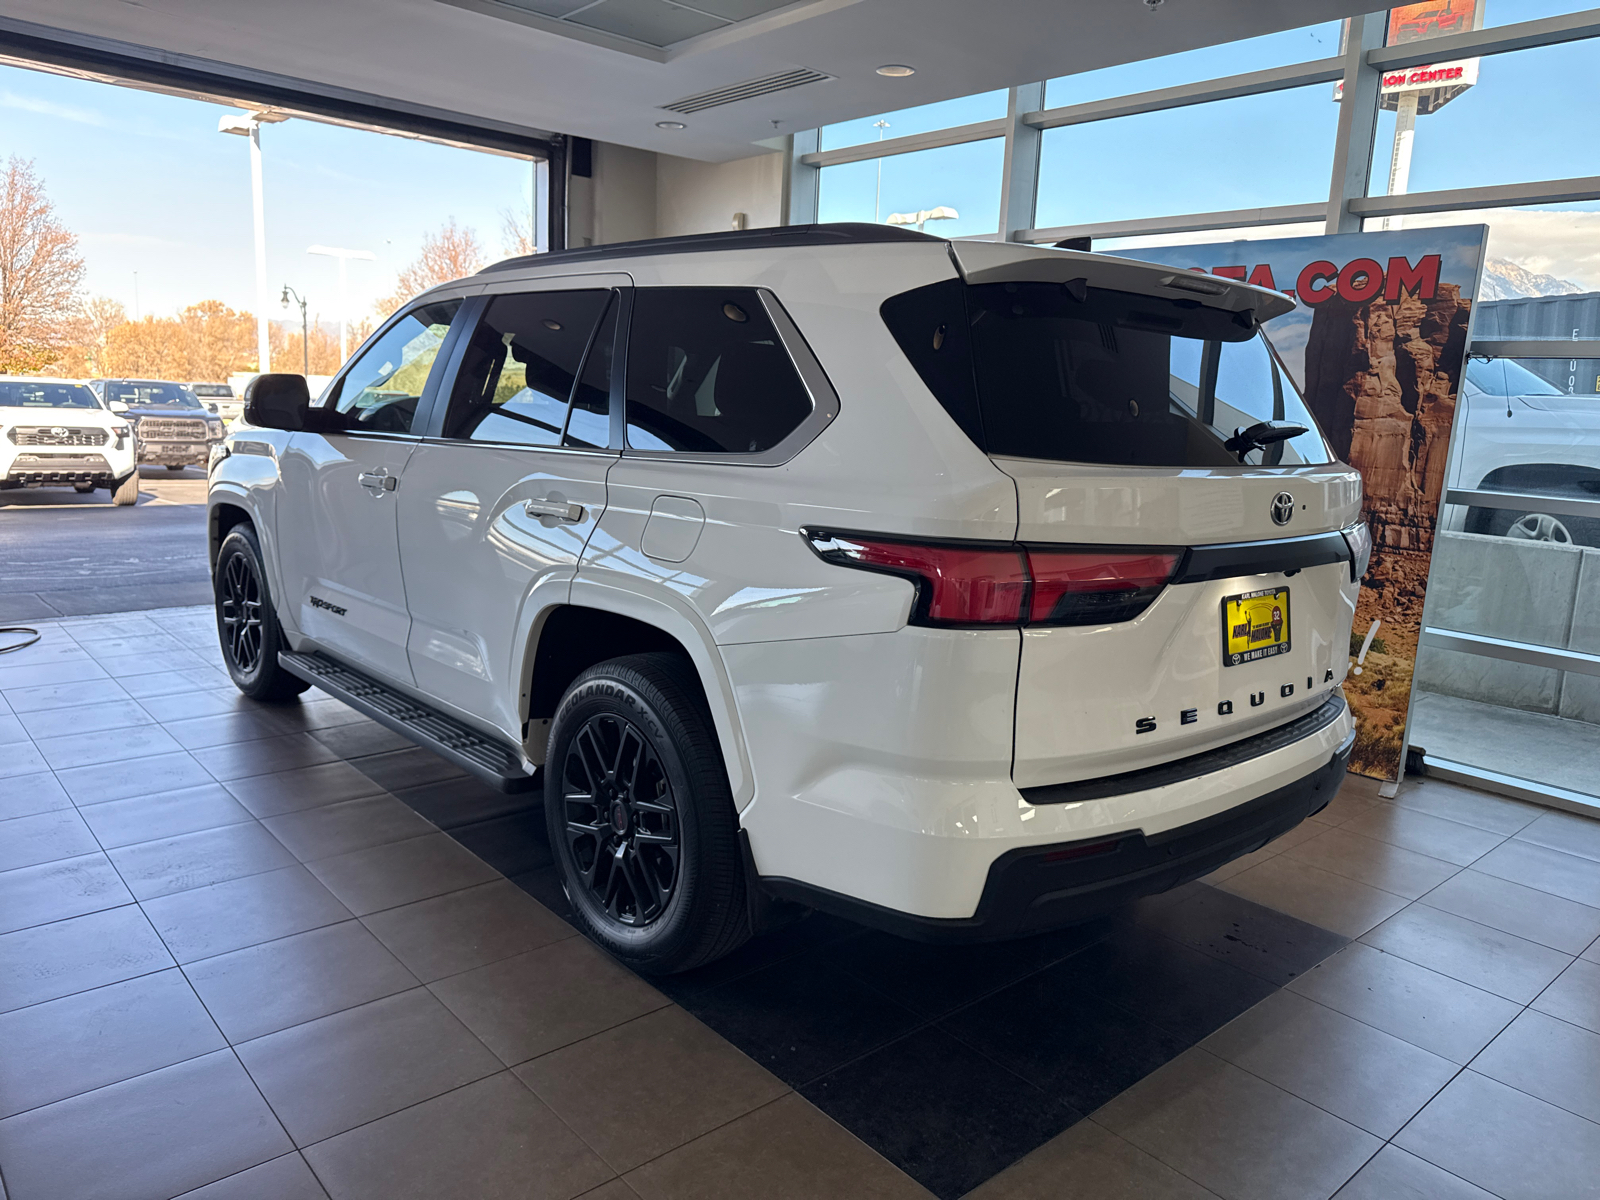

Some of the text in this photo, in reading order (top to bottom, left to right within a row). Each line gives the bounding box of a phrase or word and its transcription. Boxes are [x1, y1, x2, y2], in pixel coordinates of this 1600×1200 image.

[1409, 67, 1463, 84] CENTER
[1273, 611, 1280, 620] 32
[1243, 653, 1250, 661] WE
[1251, 650, 1262, 659] MAKE
[1268, 646, 1278, 656] EASY
[1135, 668, 1334, 735] SEQUOIA
[559, 684, 664, 742] GEOLANDAR X-CV
